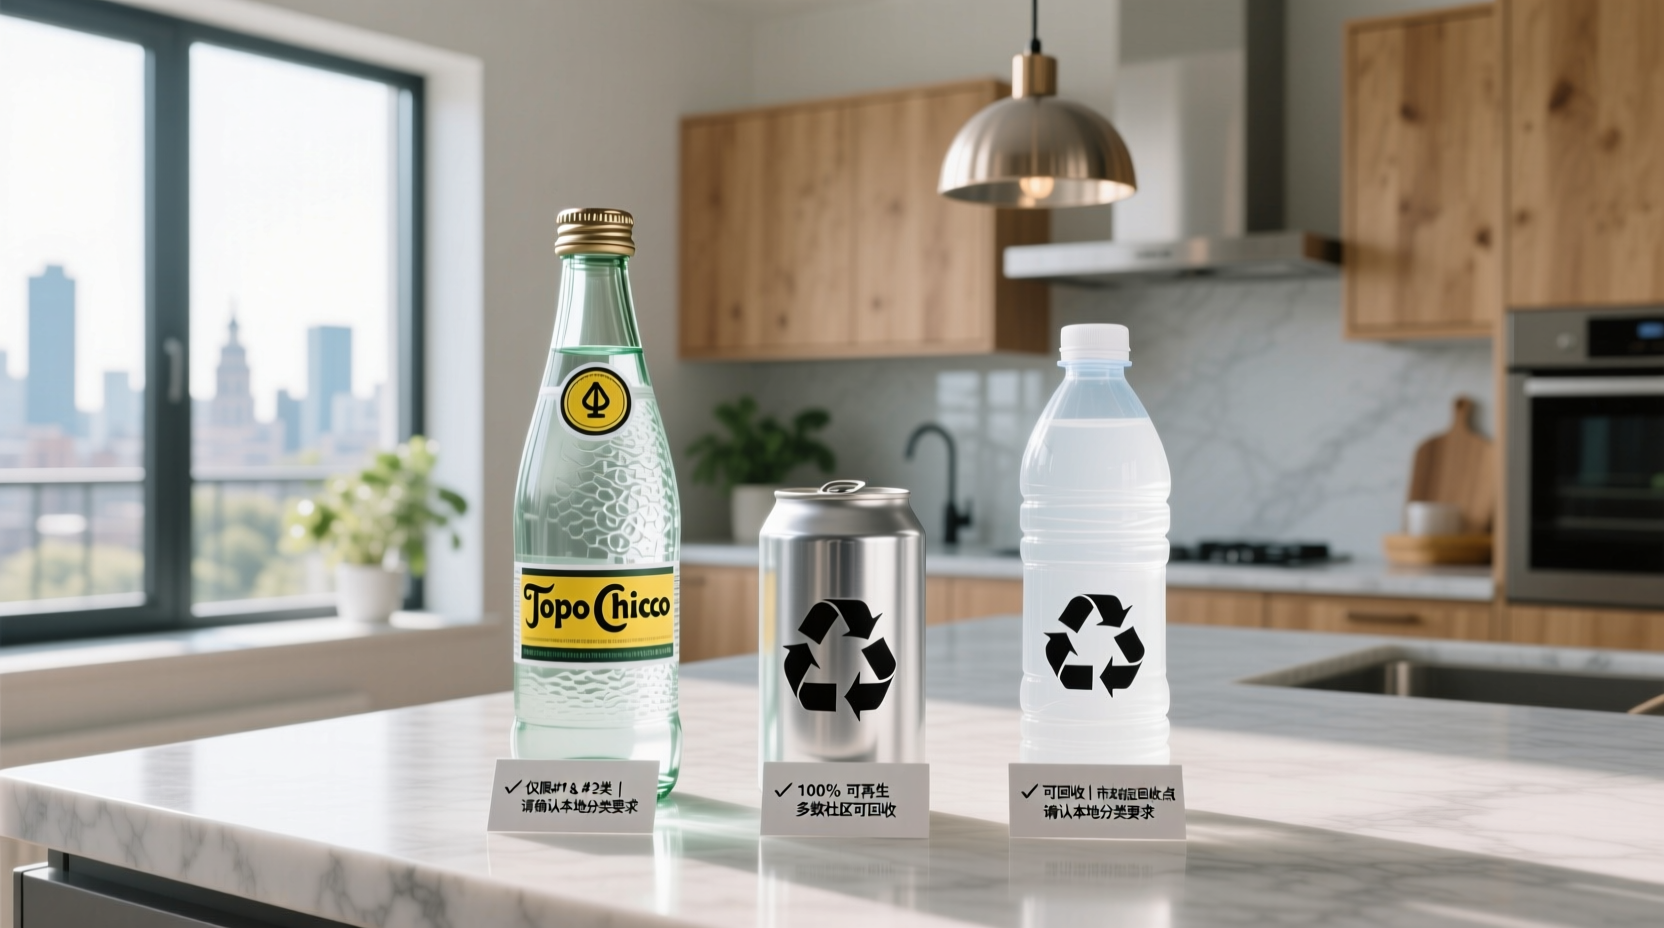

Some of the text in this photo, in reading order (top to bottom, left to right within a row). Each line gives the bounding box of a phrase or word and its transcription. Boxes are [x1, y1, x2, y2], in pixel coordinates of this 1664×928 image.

[523, 583, 590, 629] Topo
[593, 583, 671, 633] Chicco
[797, 782, 890, 800] 100% 可再生
[1042, 784, 1086, 800] 可回收
[795, 801, 897, 819] 多数社区可回收
